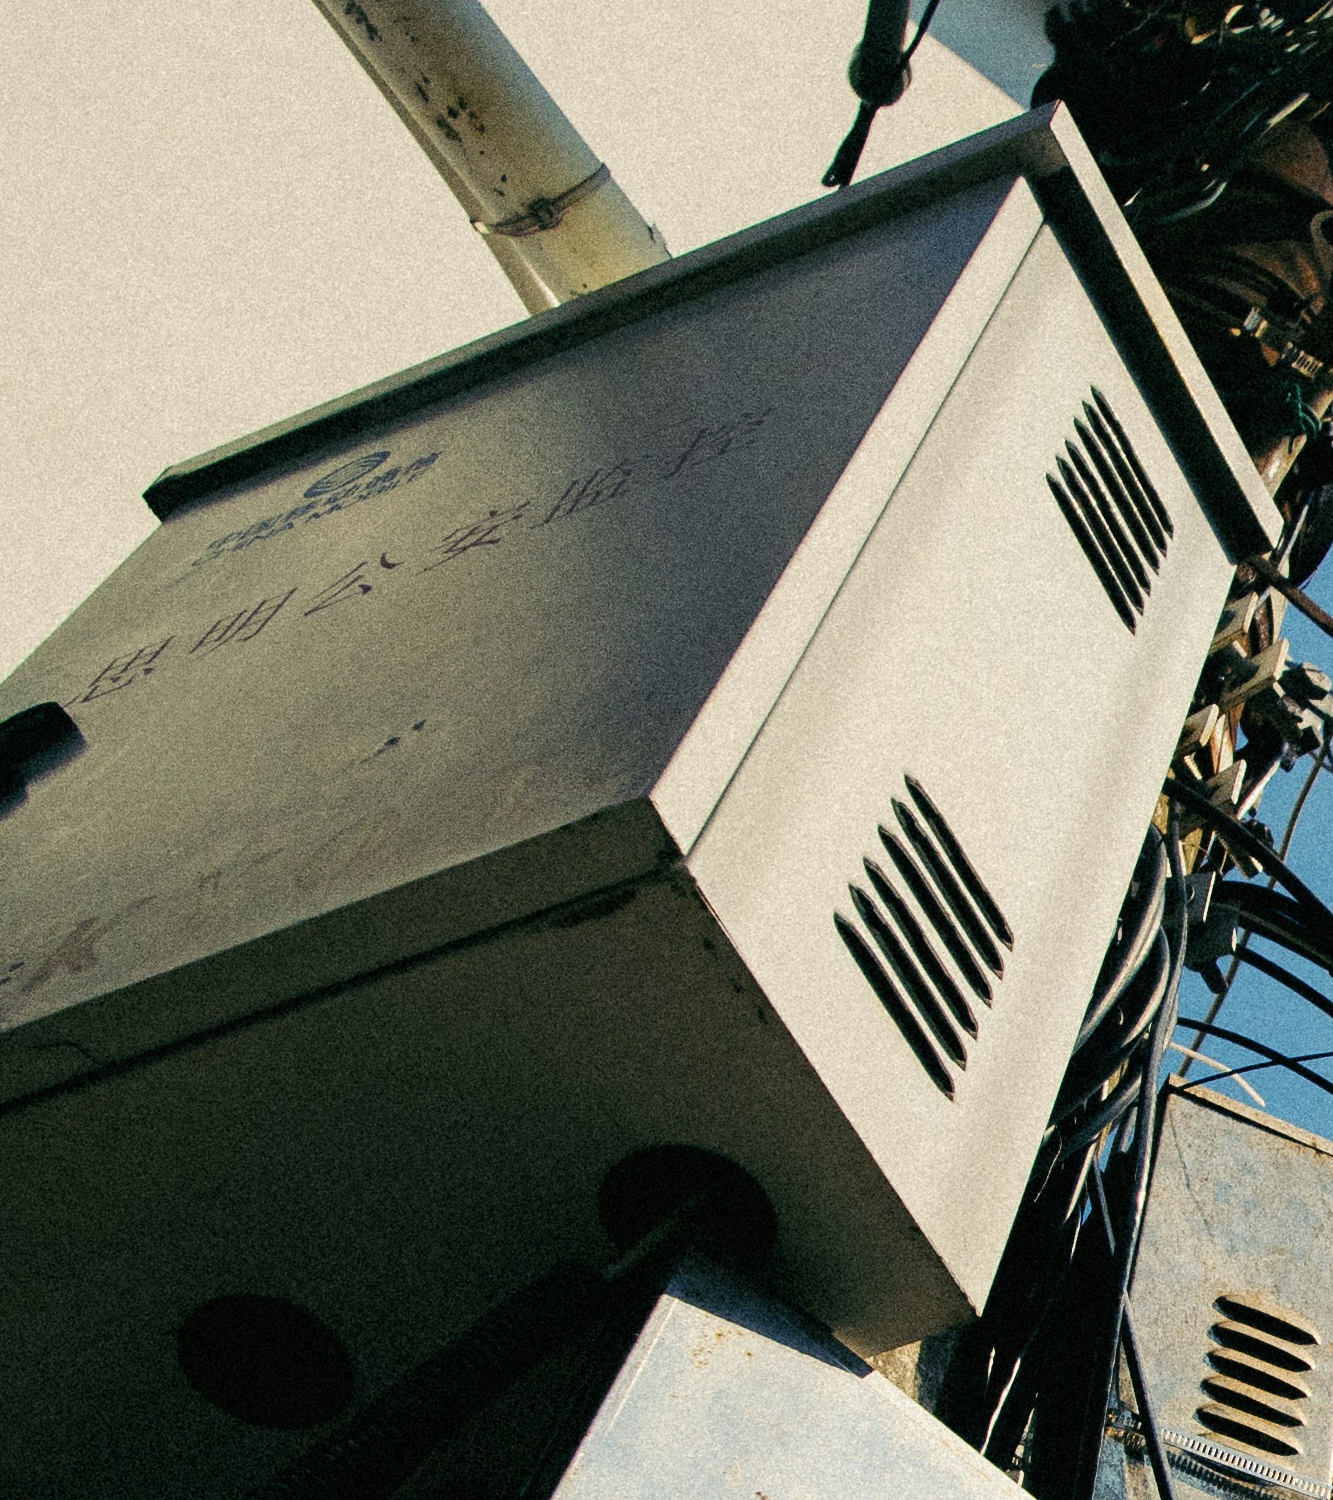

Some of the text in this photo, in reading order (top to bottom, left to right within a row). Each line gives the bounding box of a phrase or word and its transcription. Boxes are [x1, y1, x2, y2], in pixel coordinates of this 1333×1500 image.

[58, 403, 778, 711] 思明公安监控
